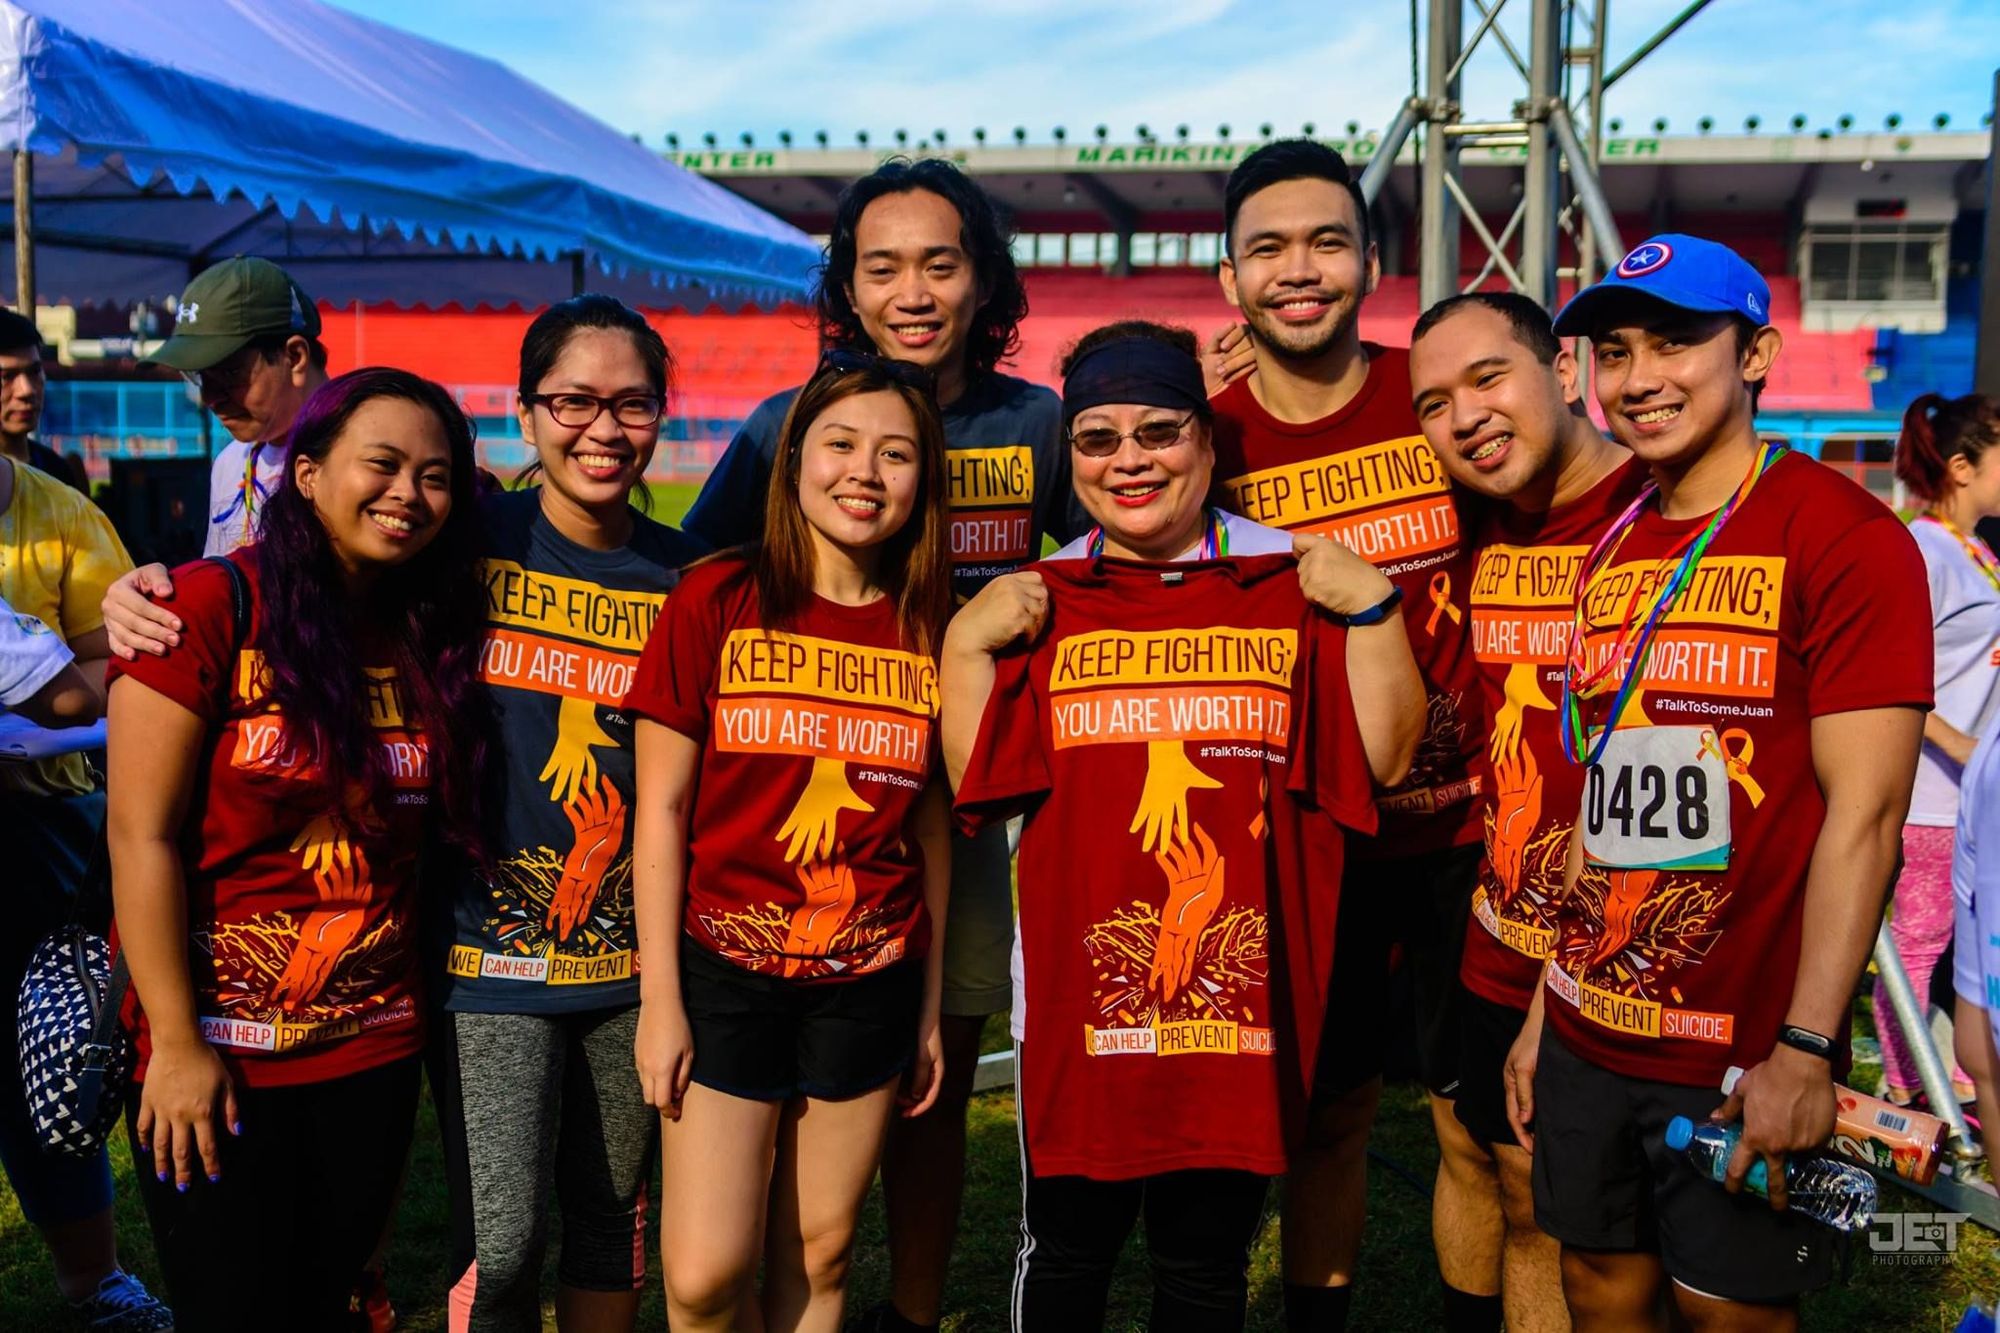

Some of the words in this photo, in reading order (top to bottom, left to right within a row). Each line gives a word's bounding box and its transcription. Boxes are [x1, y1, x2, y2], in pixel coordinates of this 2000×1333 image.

[948, 455, 1030, 499] HTING;
[1232, 476, 1290, 521] EEP
[951, 520, 1008, 553] ORTH
[1013, 518, 1027, 550] IT.
[1432, 504, 1456, 539] IT.
[1378, 548, 1460, 578] TalkToSomeJuan
[1515, 554, 1585, 597] FIGHT
[1587, 571, 1635, 622] EEP
[1058, 638, 1135, 682] KEEP
[1145, 634, 1292, 682] FIGHTING;
[1486, 620, 1522, 655] ARE
[527, 646, 580, 689] ARE
[727, 638, 807, 684] KEEP
[1739, 645, 1770, 688] IT.
[1055, 702, 1101, 739] YOU
[1108, 697, 1161, 734] ARE
[1168, 695, 1264, 733] WORTH
[1267, 700, 1287, 737] IT.
[1655, 699, 1774, 718] #TalkToSomeJuan
[721, 707, 771, 745] YOU
[778, 709, 830, 749] ARE
[836, 716, 918, 767] WORTH
[1588, 764, 1710, 840] 0428
[1501, 922, 1554, 956] PREVEN
[451, 951, 476, 974] WE
[484, 957, 511, 976] CAN
[513, 960, 545, 978] HELP
[551, 954, 627, 981] PREVENT
[203, 1021, 232, 1041] CAN
[235, 1025, 271, 1045] HELP
[1096, 1034, 1118, 1051] CAN
[1121, 1032, 1152, 1050] HELP
[1160, 1025, 1234, 1052] PREVENT
[1583, 992, 1656, 1033] PREVENT
[1665, 1011, 1729, 1042] SUICIDE.
